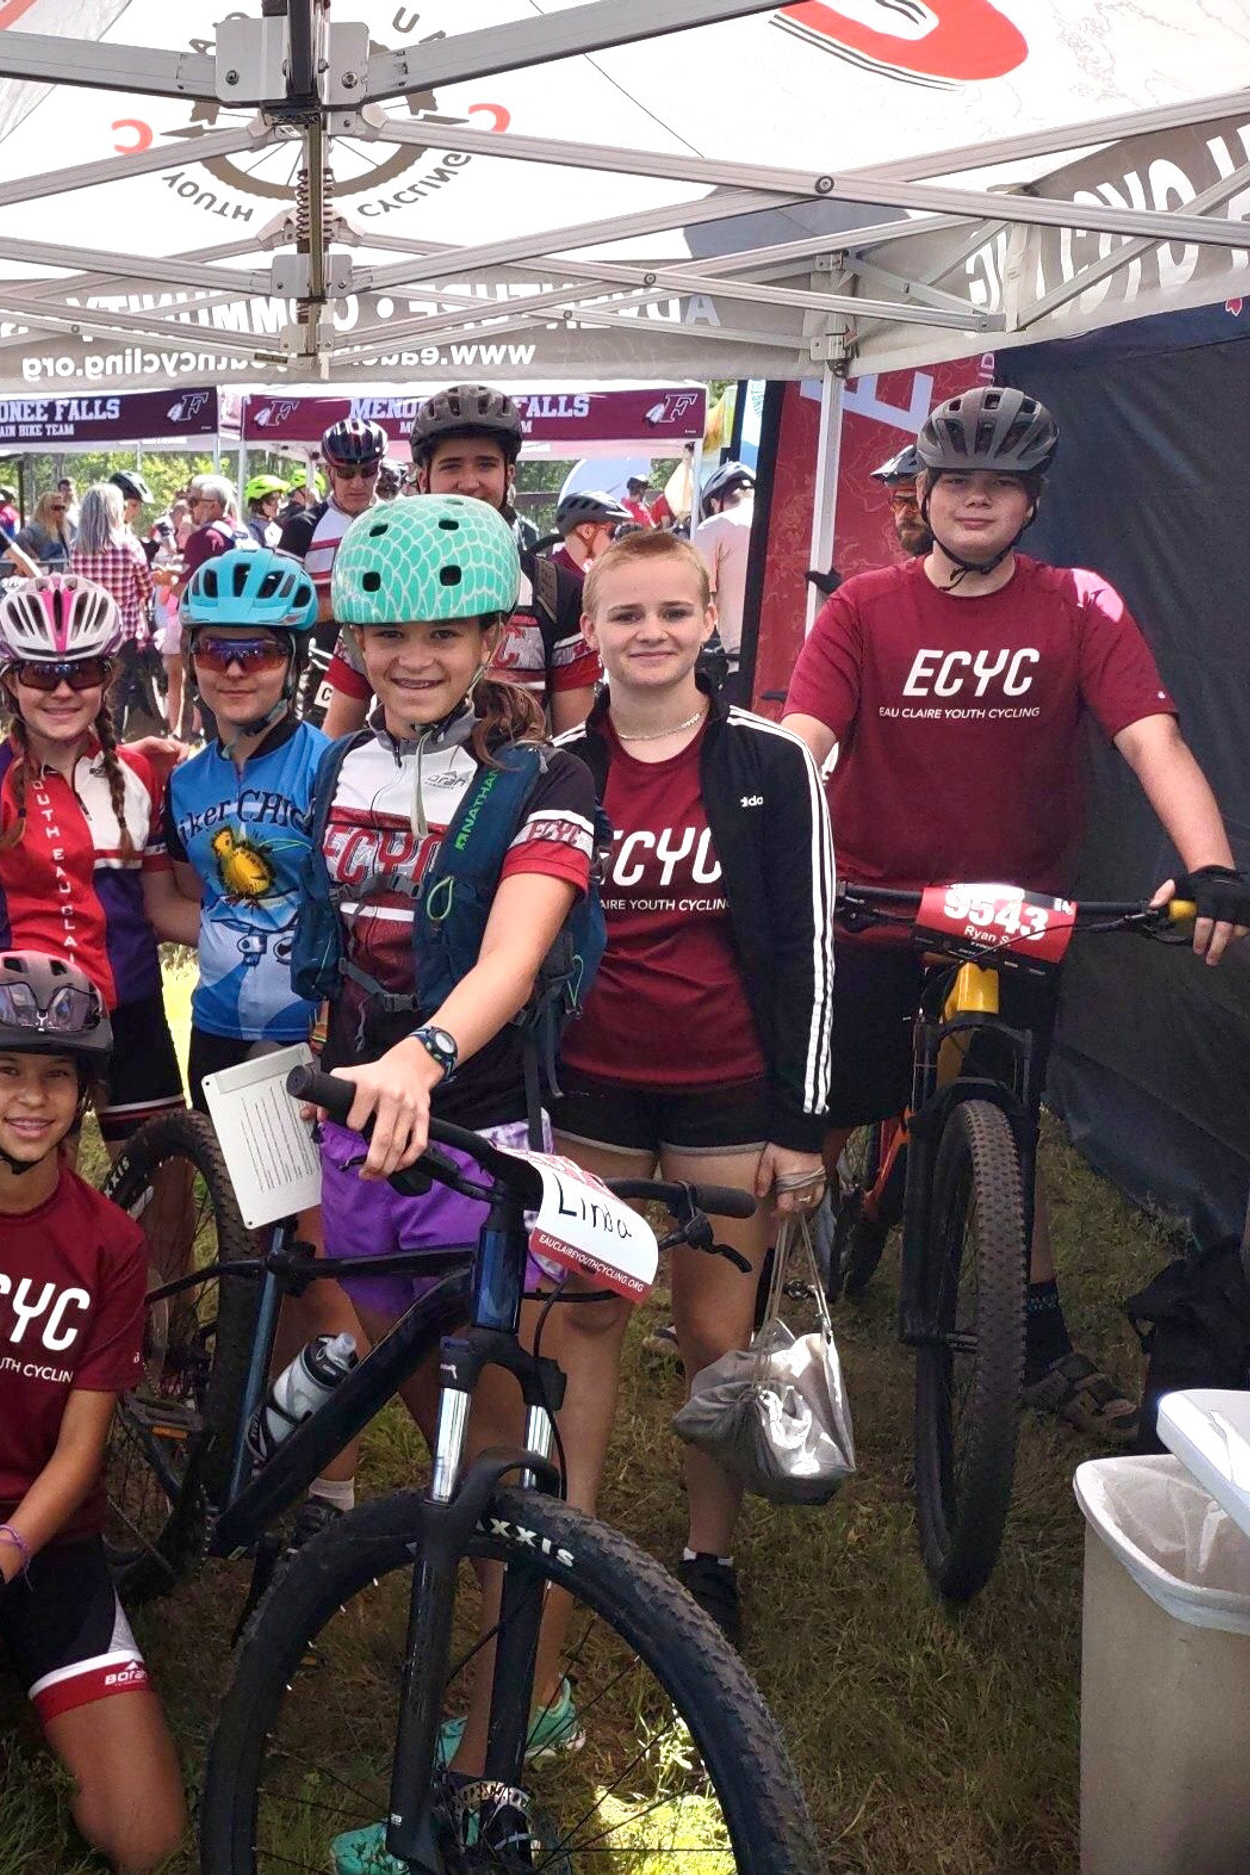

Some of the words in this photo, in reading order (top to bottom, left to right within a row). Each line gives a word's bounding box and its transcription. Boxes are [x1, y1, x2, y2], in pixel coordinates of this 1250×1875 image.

[54, 398, 120, 422] FALLS
[18, 424, 43, 438] BIKE
[45, 424, 75, 437] TEAM
[902, 648, 1040, 697] ECYC
[879, 707, 900, 718] EAU
[901, 708, 942, 719] CLAIRE
[944, 708, 986, 719] YOUTH
[988, 707, 1040, 719] CYCLING
[178, 799, 232, 845] iker
[600, 899, 626, 910] AIRE
[631, 899, 675, 911] YOUTH
[943, 884, 1049, 941] 9543
[964, 924, 997, 942] Ryan
